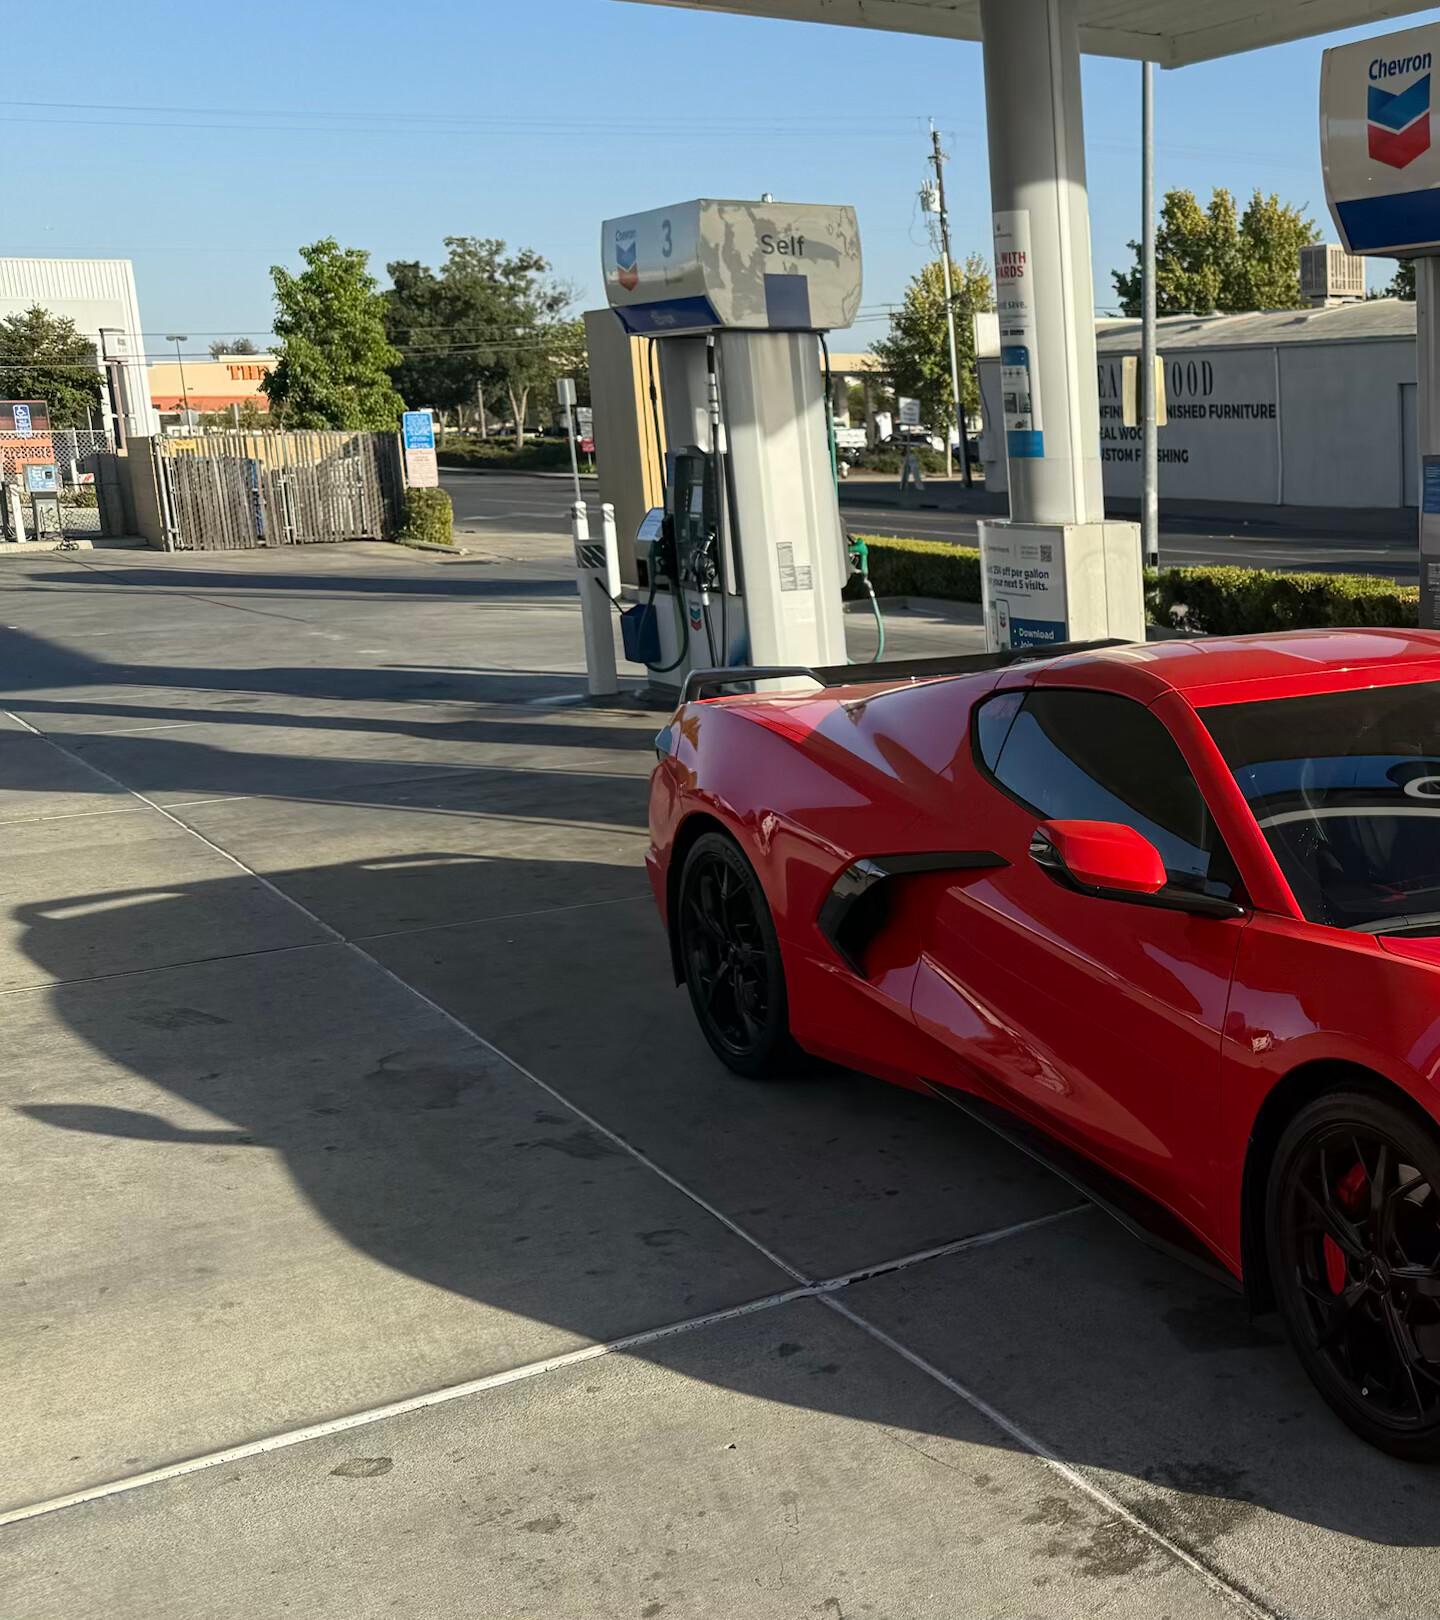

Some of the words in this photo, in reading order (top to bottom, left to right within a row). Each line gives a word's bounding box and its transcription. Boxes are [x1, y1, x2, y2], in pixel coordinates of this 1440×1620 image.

[1368, 50, 1432, 82] Chevron
[661, 219, 673, 259] 3
[760, 234, 805, 257] Self
[1000, 251, 1026, 265] WITH
[1209, 403, 1277, 420] FURNITURE
[1099, 427, 1117, 440] EAL
[1024, 568, 1049, 580] gallon
[1019, 628, 1055, 640] Download
